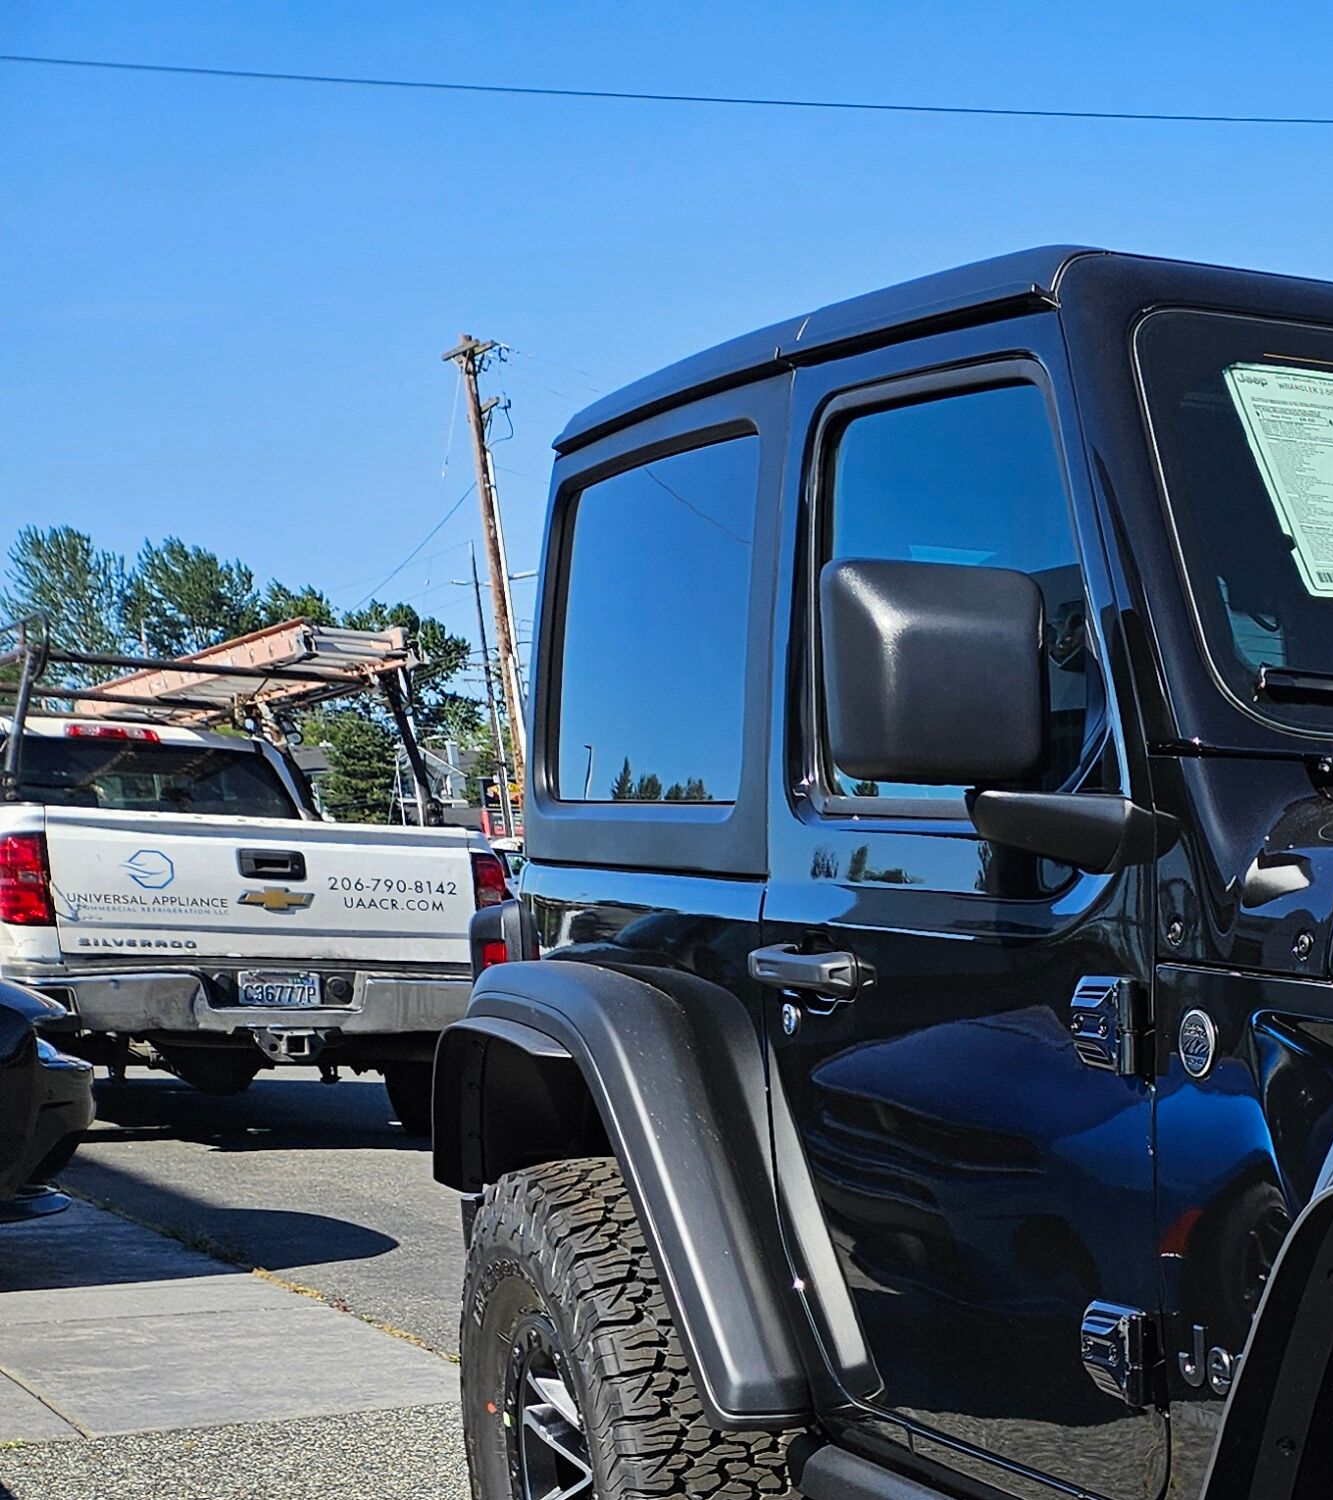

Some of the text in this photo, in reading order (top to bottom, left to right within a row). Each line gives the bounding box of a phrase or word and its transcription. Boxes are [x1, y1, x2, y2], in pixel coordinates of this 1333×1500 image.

[328, 876, 457, 896] 206-790-8142
[66, 893, 228, 908] UNIVERSAL APPLIANCE
[344, 897, 444, 912] UAACR.COM
[78, 937, 197, 949] SILVERADO
[1178, 1324, 1243, 1395] Je
